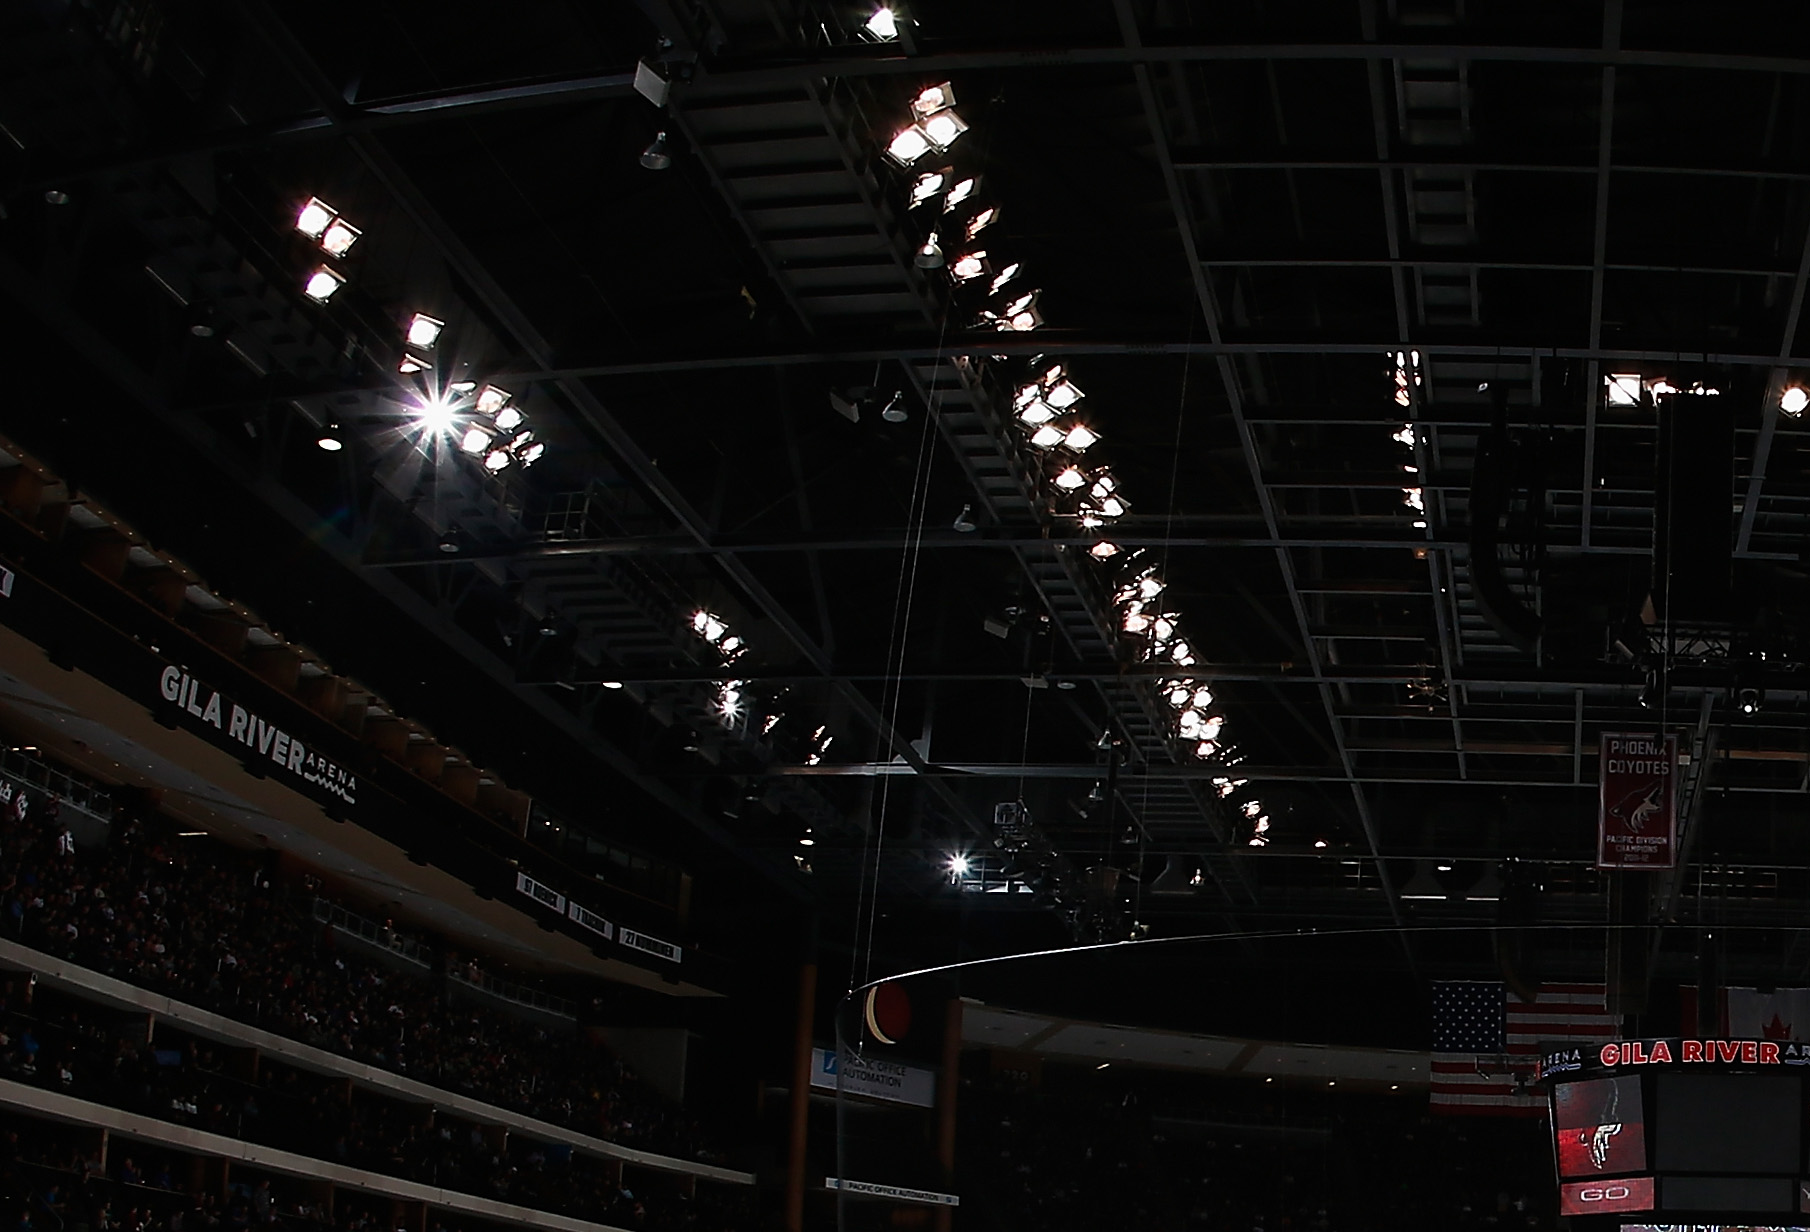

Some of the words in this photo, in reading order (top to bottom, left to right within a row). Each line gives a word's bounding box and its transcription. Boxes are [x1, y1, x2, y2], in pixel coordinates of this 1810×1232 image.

[160, 664, 222, 730] GILA
[229, 703, 305, 776] RIVER
[306, 751, 357, 790] ARENA
[1608, 760, 1669, 775] COYOTES
[1600, 1040, 1672, 1067] GILA
[1682, 1040, 1780, 1065] RIVER
[877, 1060, 907, 1076] OFFICE
[843, 1068, 901, 1088] AUTOMATION
[1580, 1187, 1629, 1201] GO
